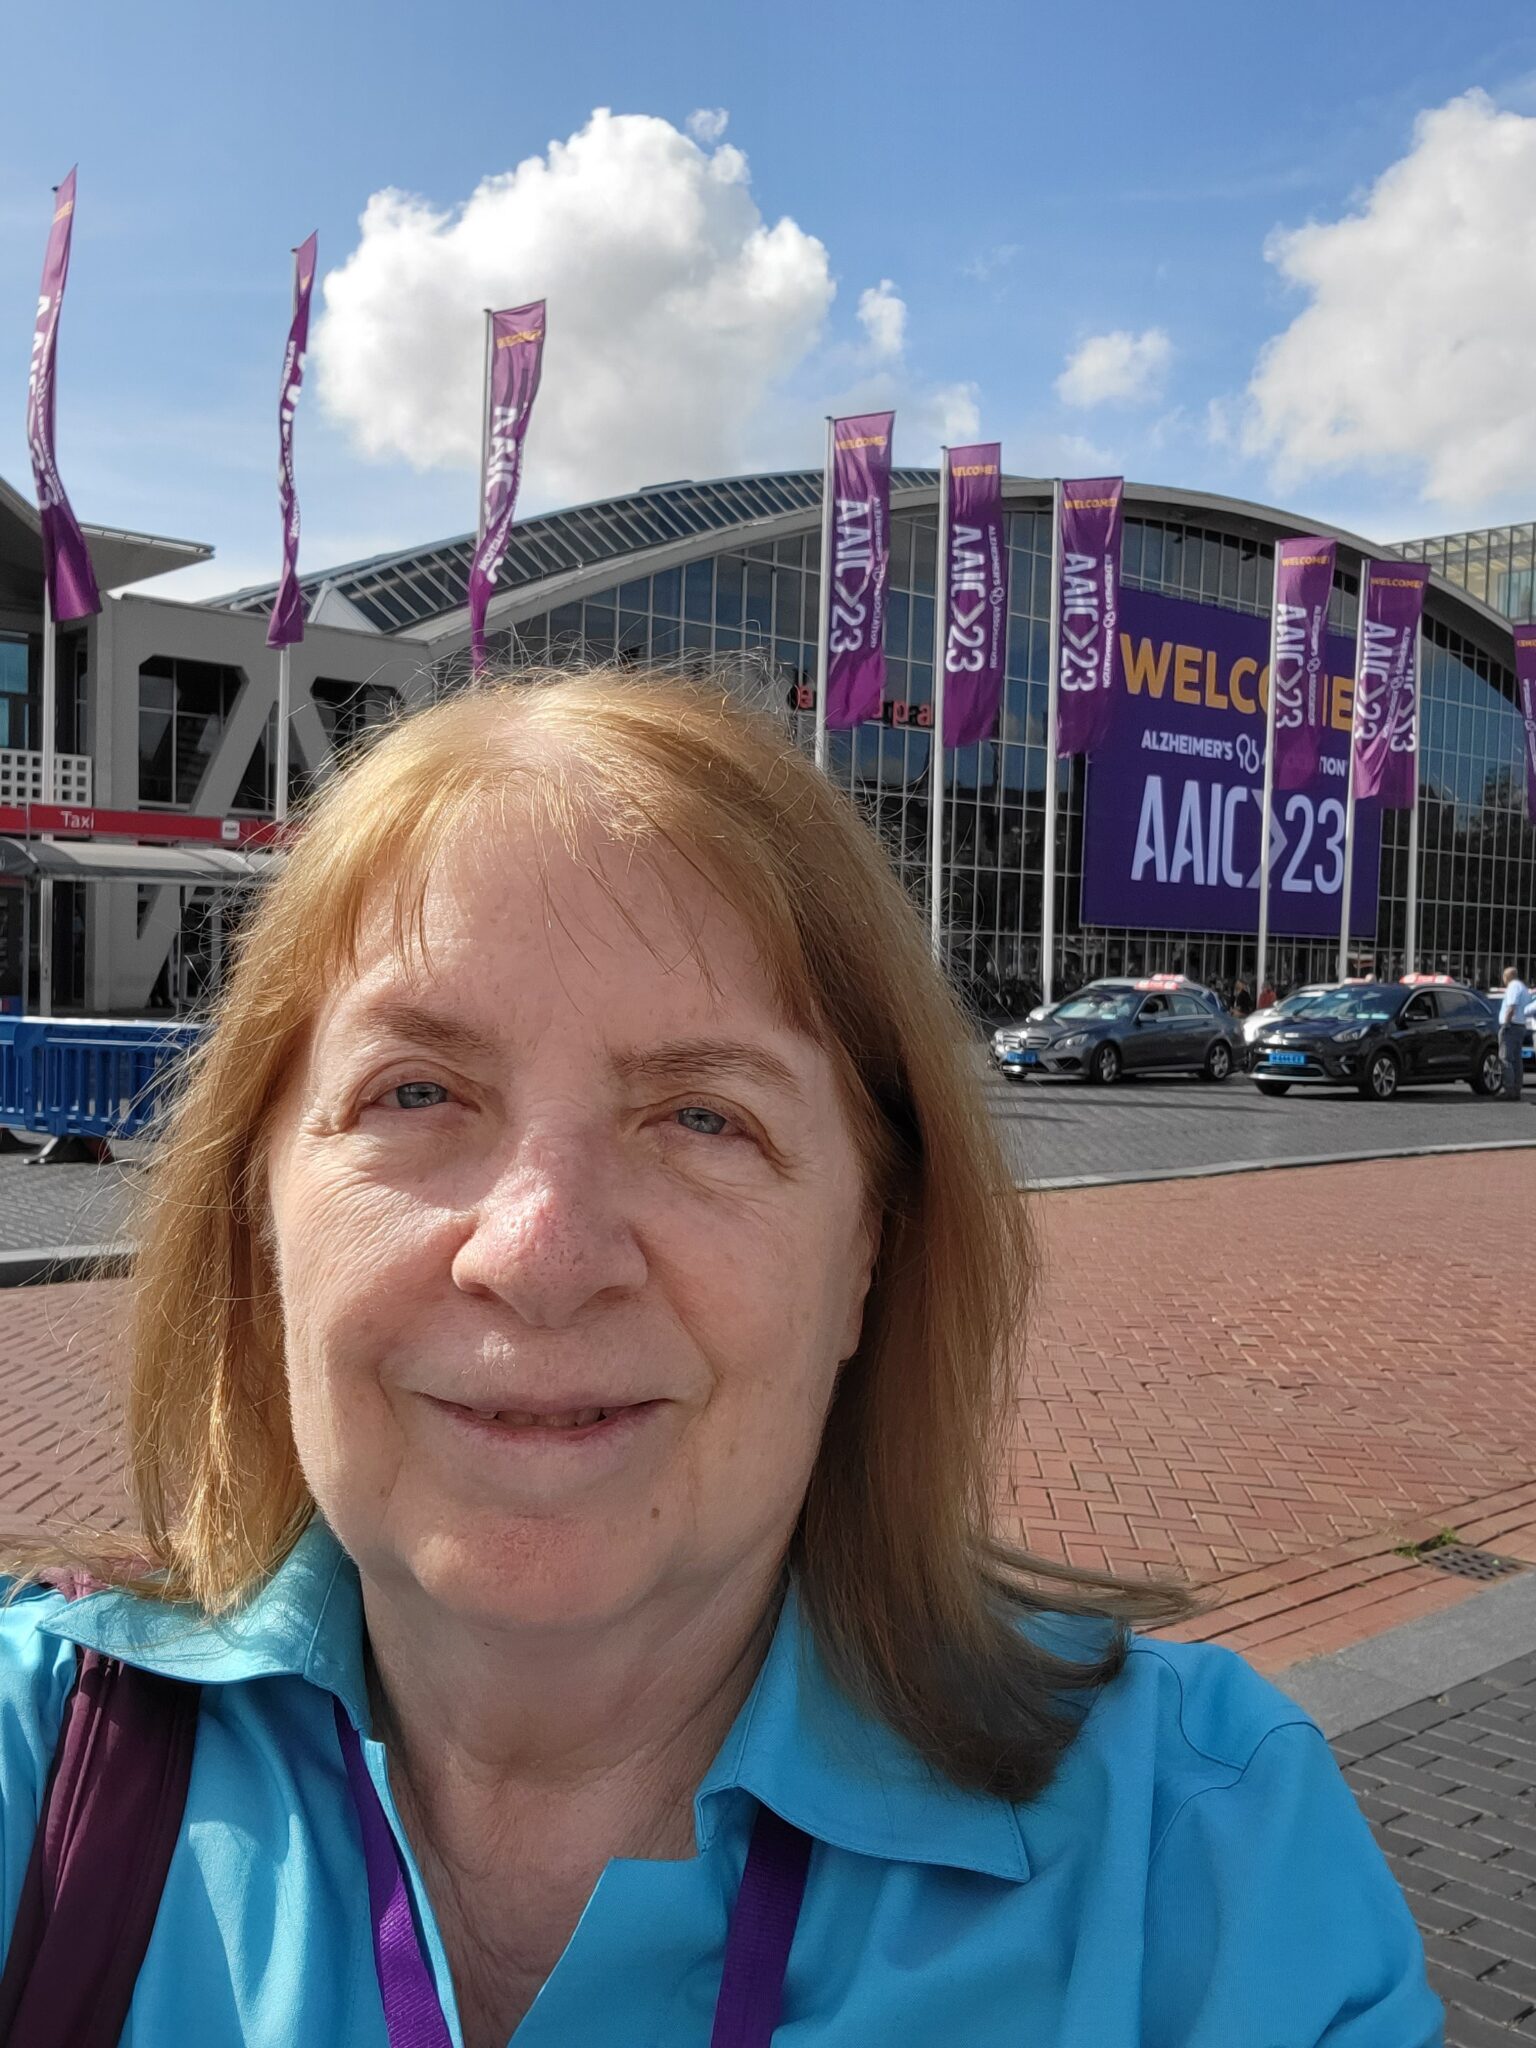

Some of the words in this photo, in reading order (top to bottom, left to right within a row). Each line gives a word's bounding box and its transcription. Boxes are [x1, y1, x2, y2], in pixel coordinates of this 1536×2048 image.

[1120, 633, 1355, 732] WELCE
[1141, 729, 1233, 761] ALZHEIMER'S
[60, 810, 95, 829] Taxi
